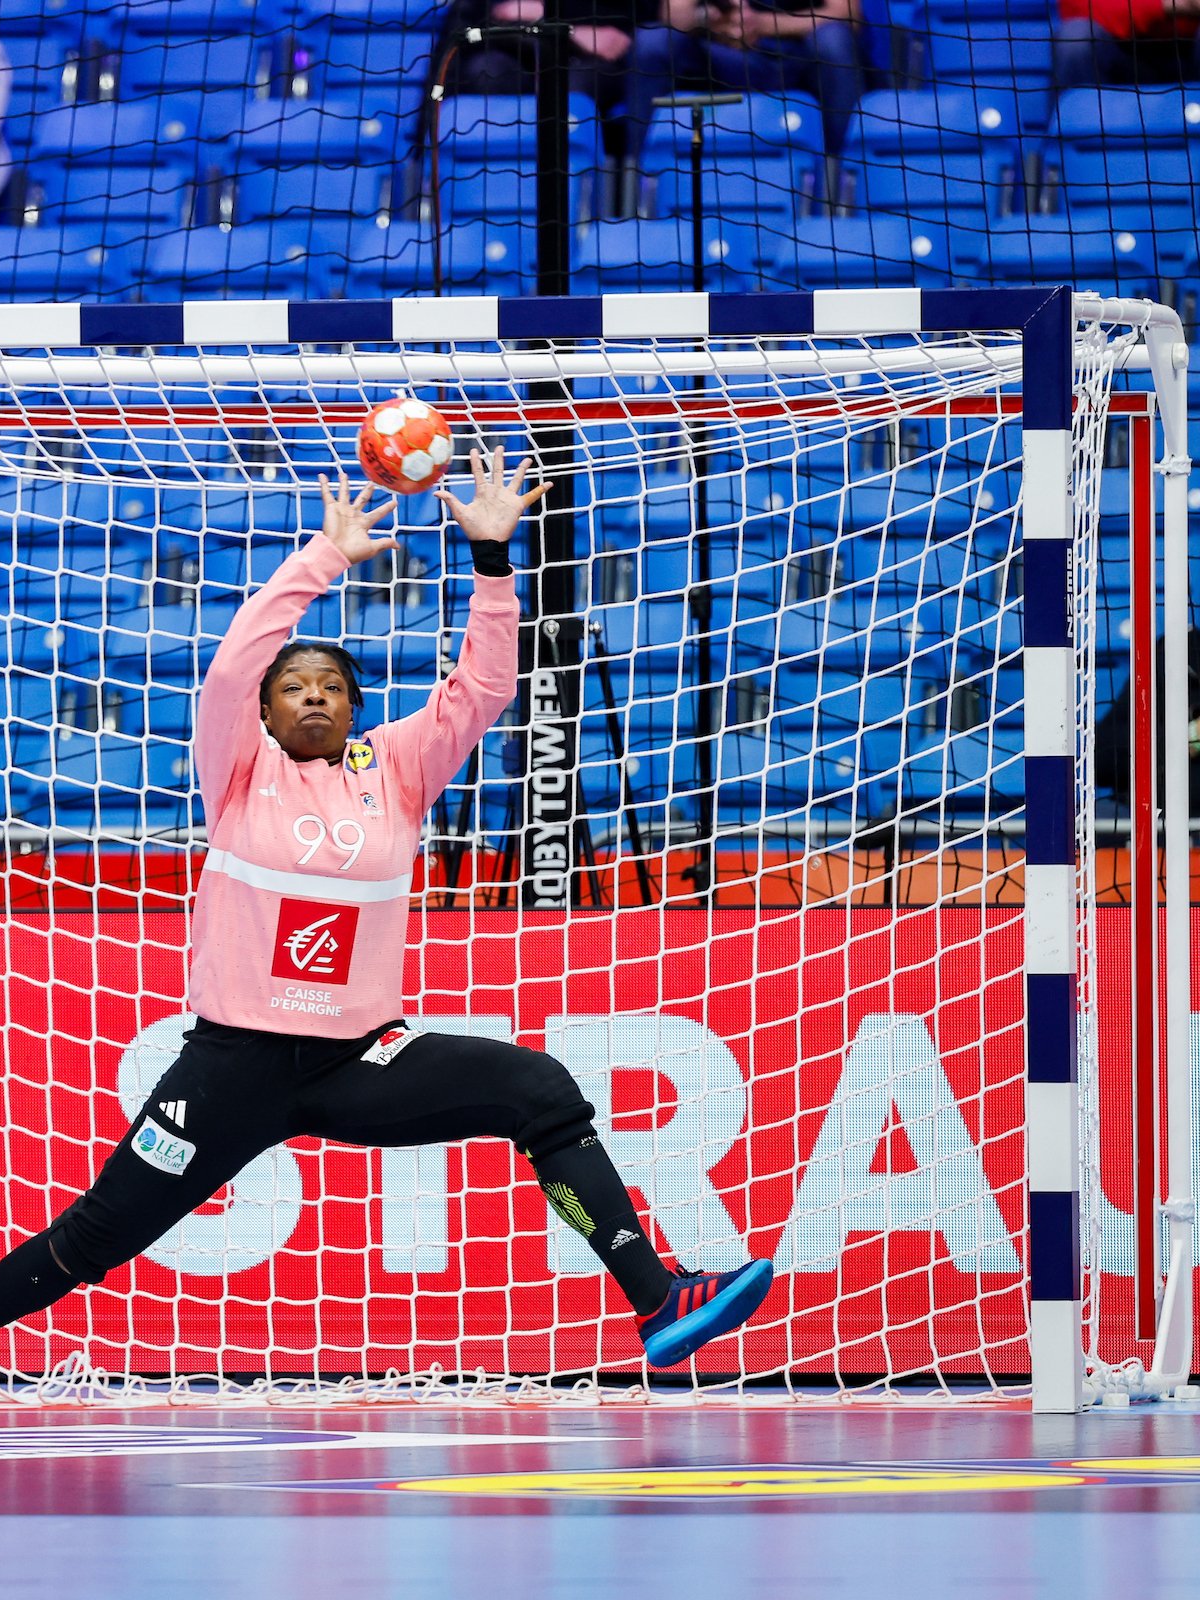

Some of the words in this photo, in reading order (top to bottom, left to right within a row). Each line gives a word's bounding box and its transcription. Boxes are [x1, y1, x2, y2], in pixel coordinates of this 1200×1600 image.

[292, 814, 366, 871] 99
[285, 986, 332, 1003] CAISSE
[270, 996, 343, 1017] D'EPARGNE
[152, 1152, 182, 1169] NATURE
[156, 1139, 185, 1163] LÉA
[611, 1232, 640, 1250] adidas
